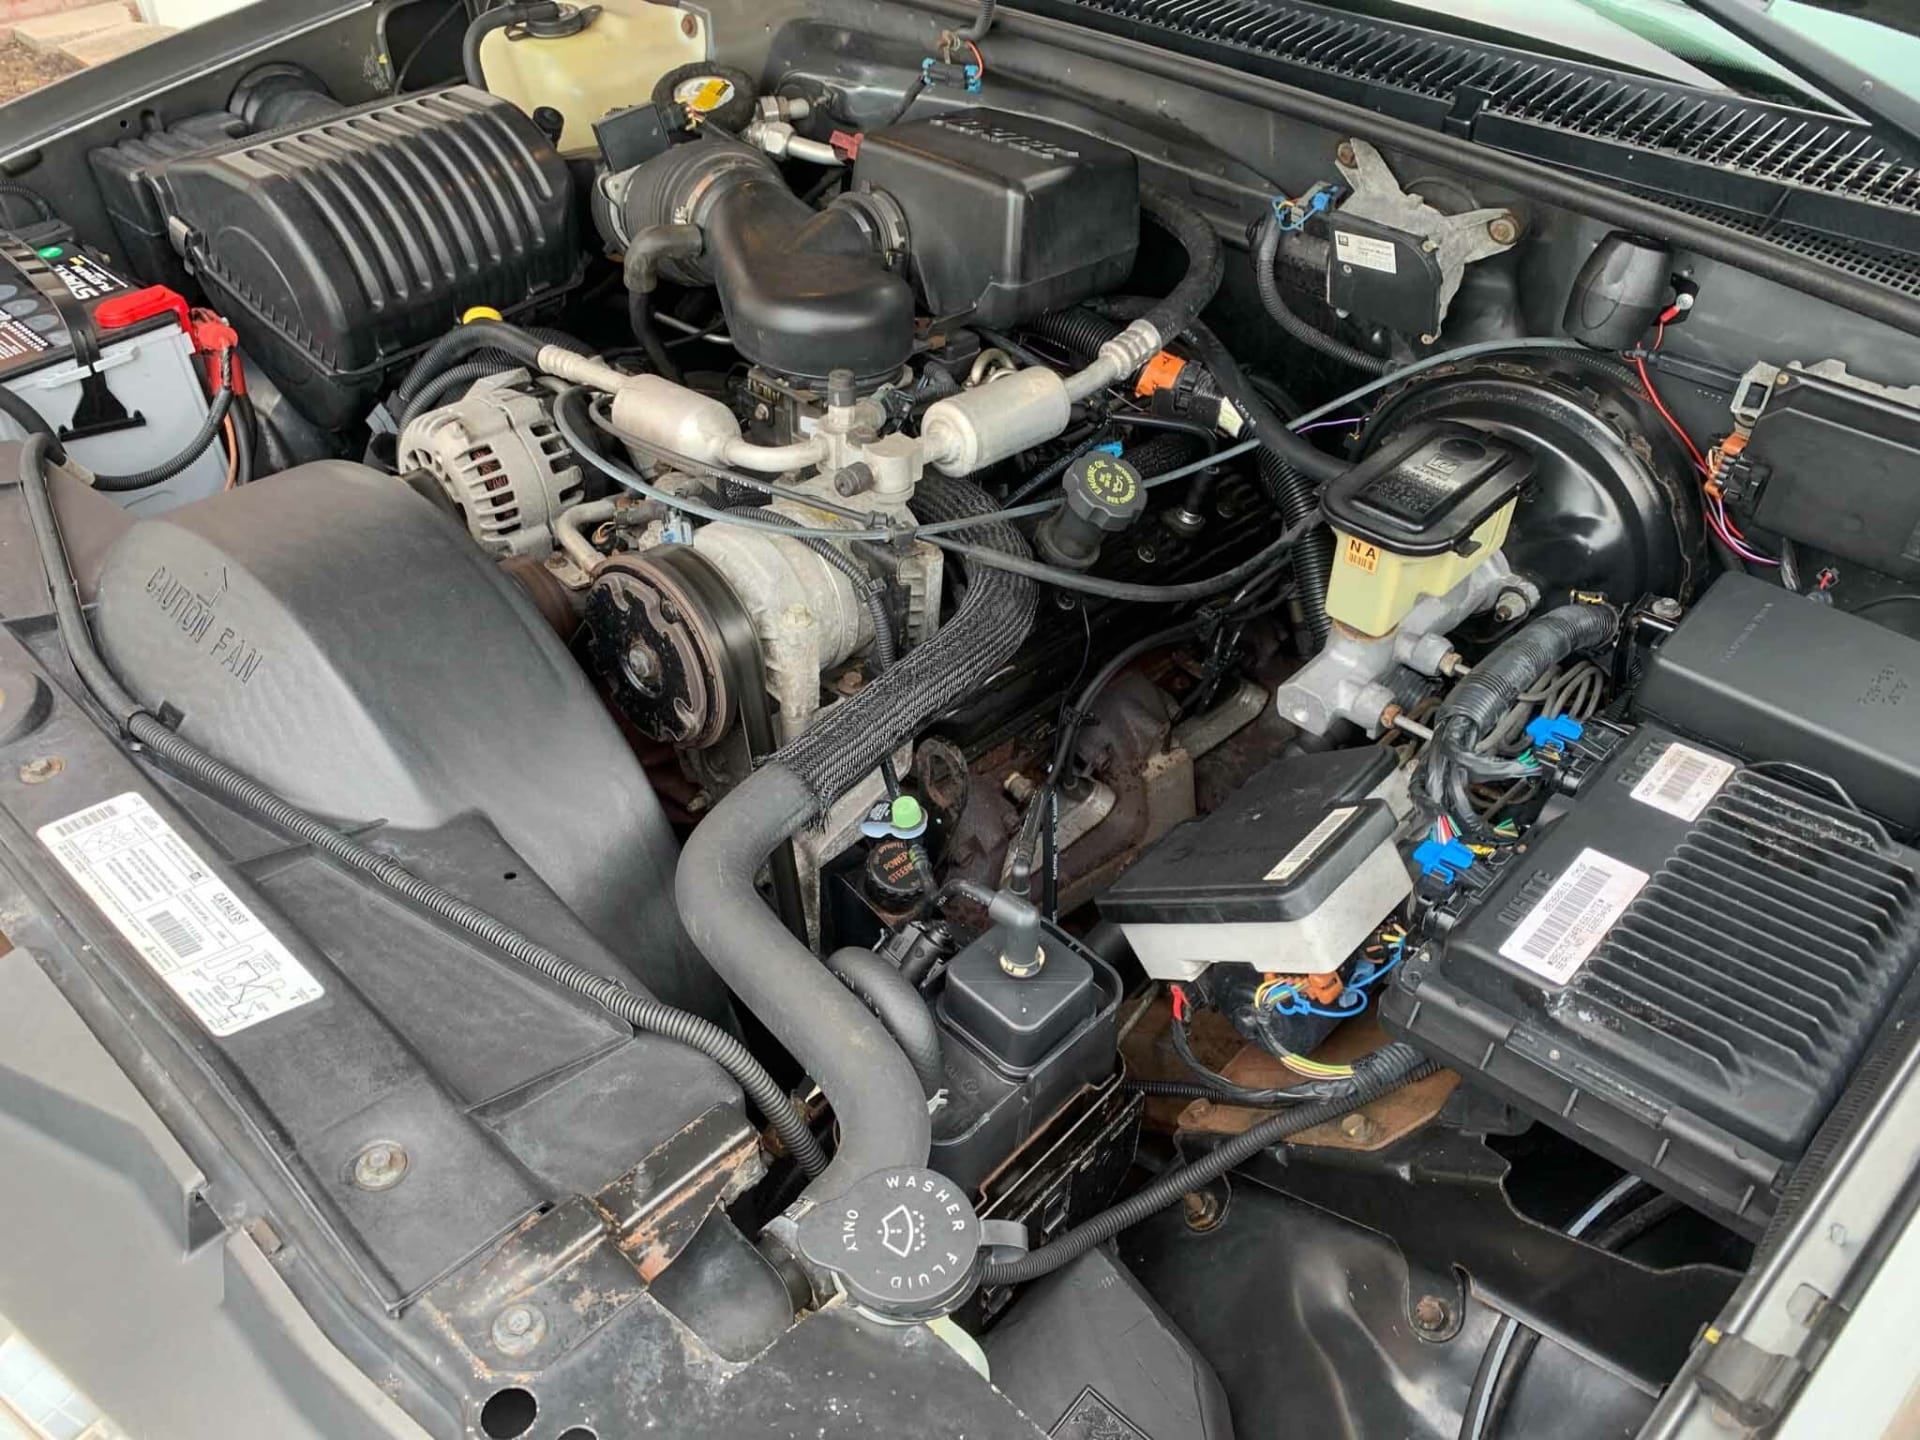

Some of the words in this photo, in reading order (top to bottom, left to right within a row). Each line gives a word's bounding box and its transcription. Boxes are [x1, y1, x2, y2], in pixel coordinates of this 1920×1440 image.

[1087, 465, 1103, 494] ENGINE
[1094, 459, 1109, 468] OIL
[1350, 539, 1362, 553] N
[1365, 547, 1378, 560] A
[146, 565, 215, 644] CAUTION
[210, 627, 263, 685] FAN
[212, 892, 249, 926] CATALYST
[886, 1175, 965, 1231] WASHER
[842, 1209, 859, 1252] ONLY
[890, 1252, 959, 1289] FLUID
